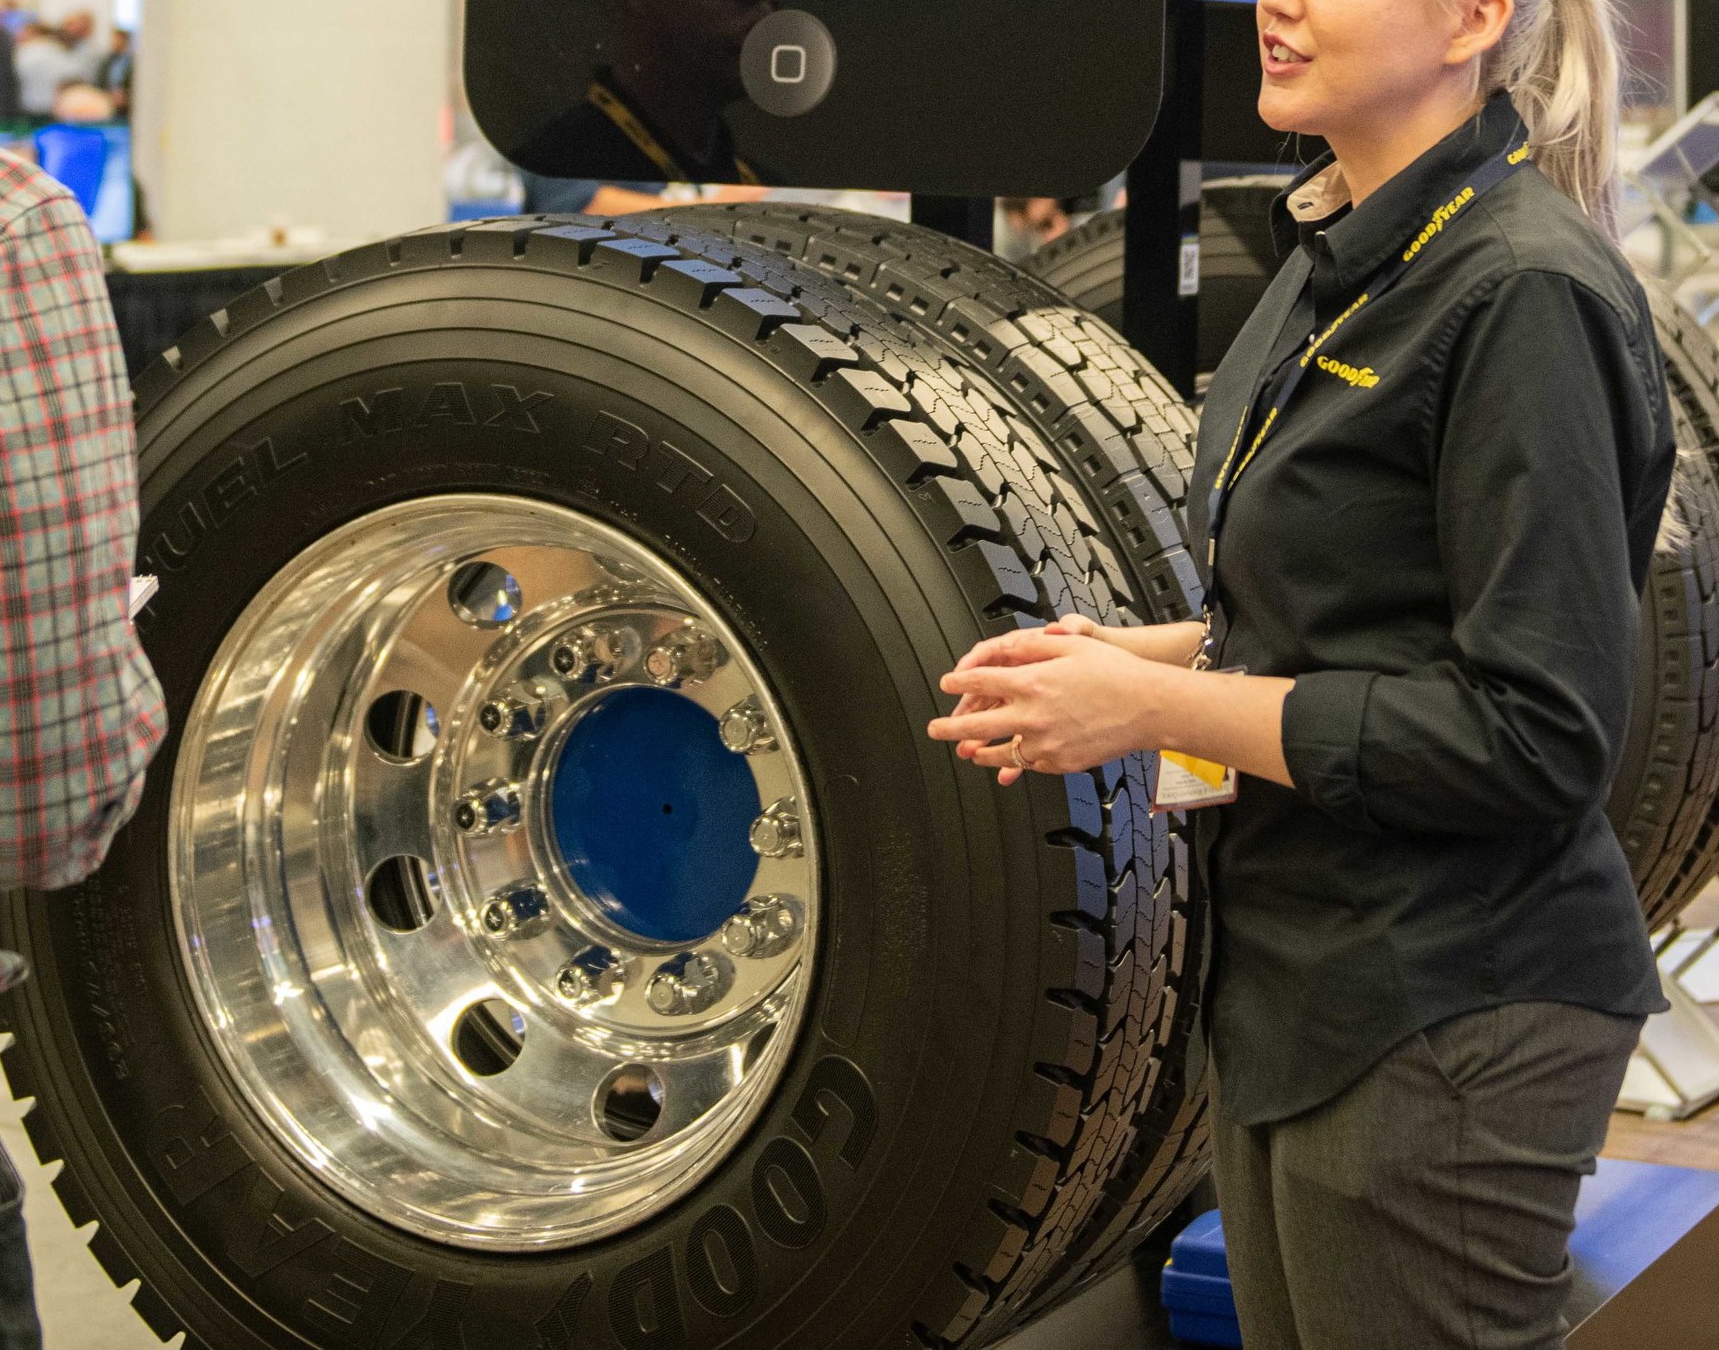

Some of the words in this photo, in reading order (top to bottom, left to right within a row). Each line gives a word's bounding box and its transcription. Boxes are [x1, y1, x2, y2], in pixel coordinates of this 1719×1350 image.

[1402, 186, 1475, 262] GOODYEAR
[338, 380, 555, 448] MAX
[582, 408, 760, 545] RTD
